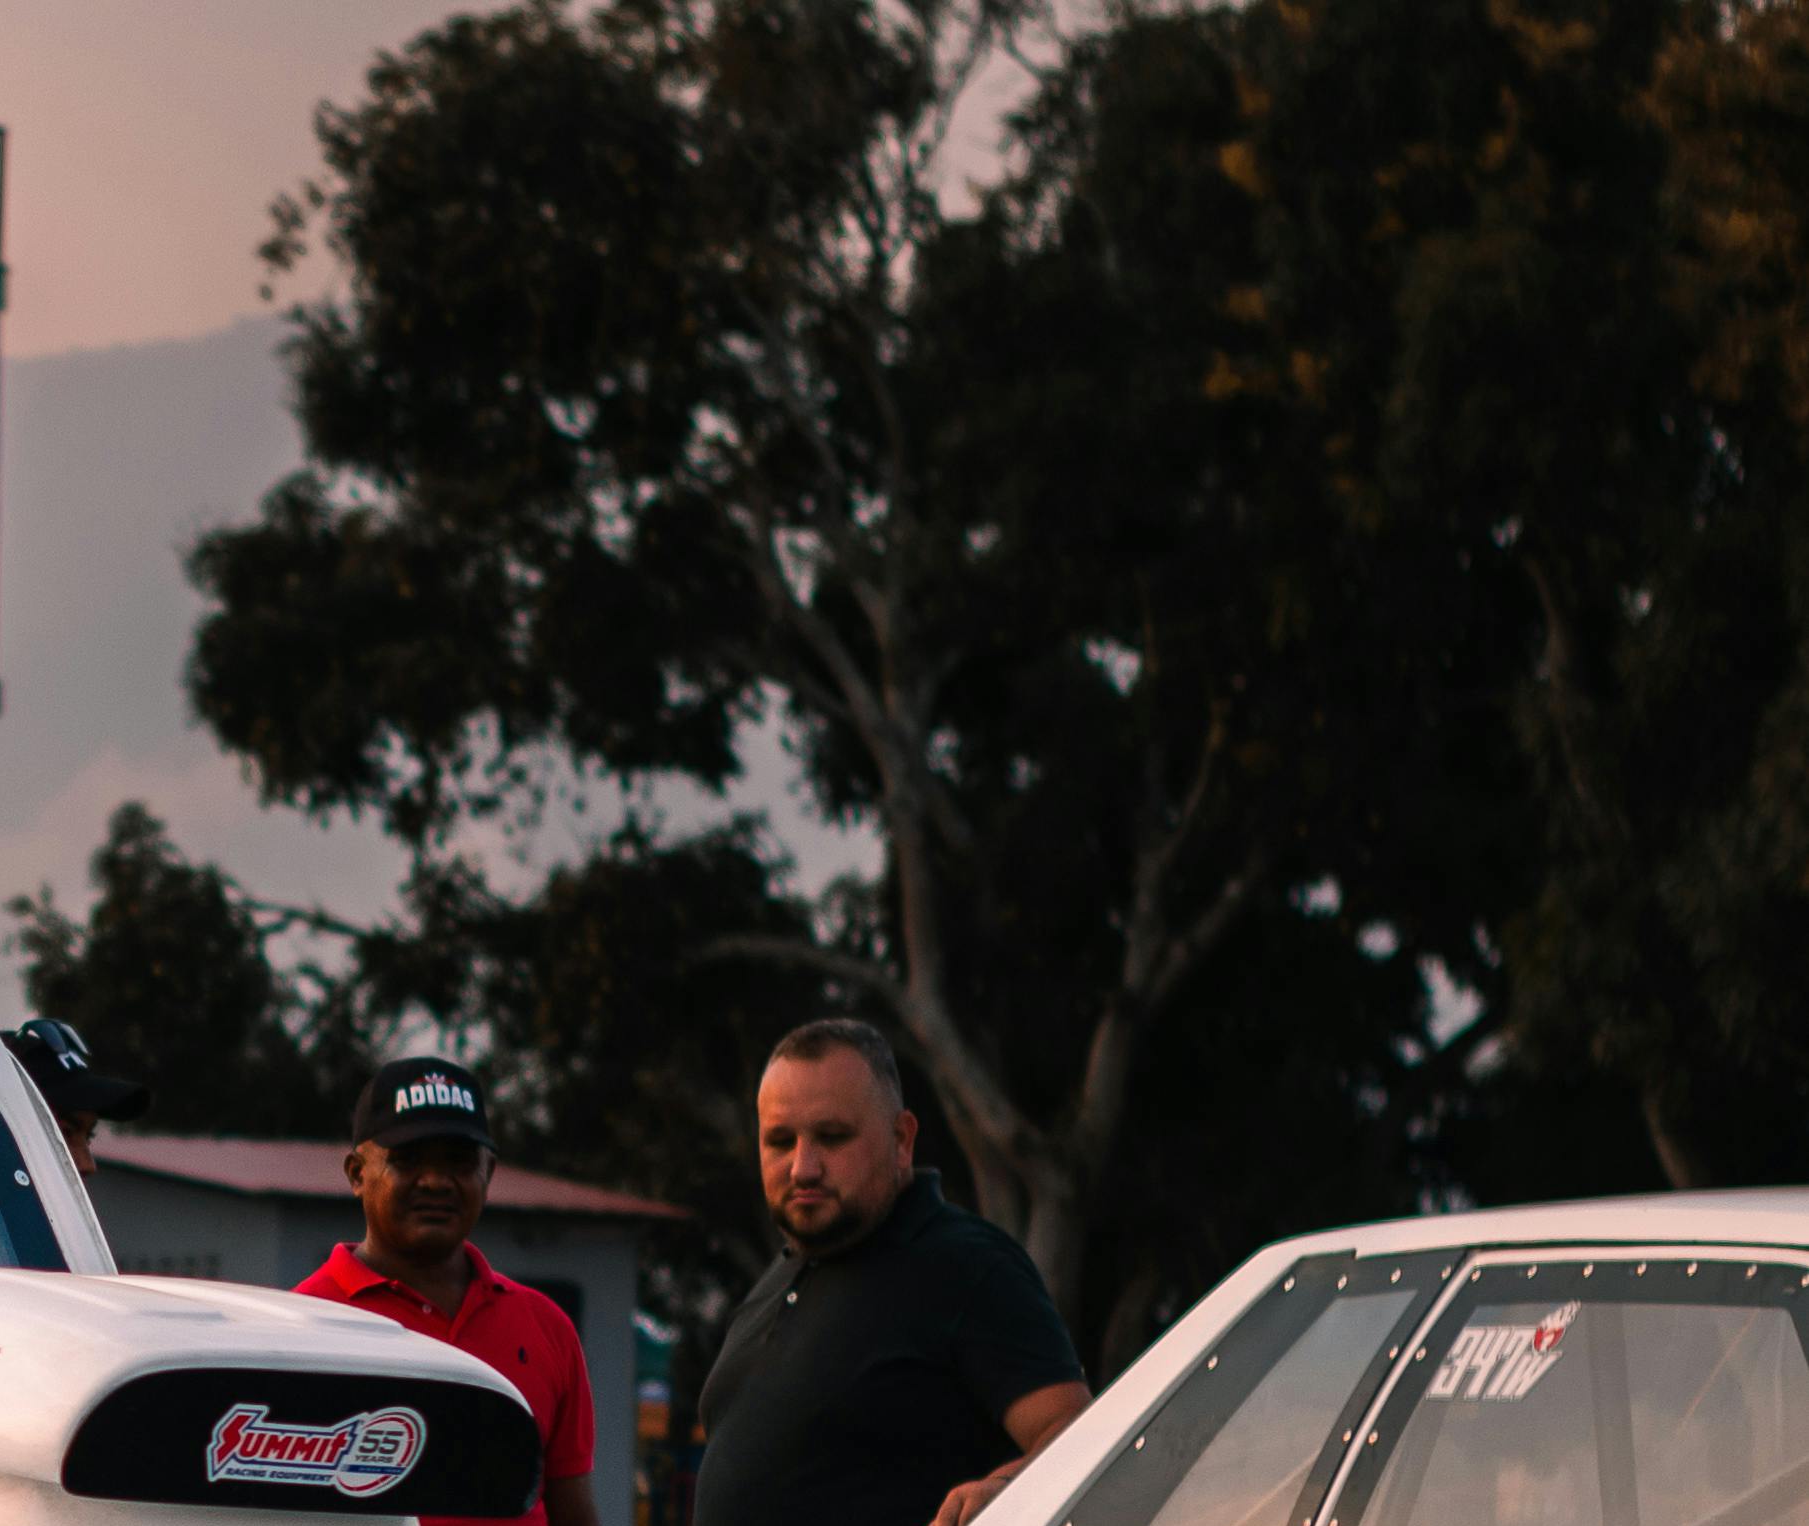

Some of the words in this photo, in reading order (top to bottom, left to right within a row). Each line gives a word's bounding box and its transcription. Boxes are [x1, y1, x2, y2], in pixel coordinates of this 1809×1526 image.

[395, 1083, 475, 1113] ADIDAS
[358, 1429, 405, 1455] 55
[354, 1454, 394, 1464] YEARS
[225, 1467, 267, 1478] RACING
[269, 1470, 336, 1482] EQUIPMENT
